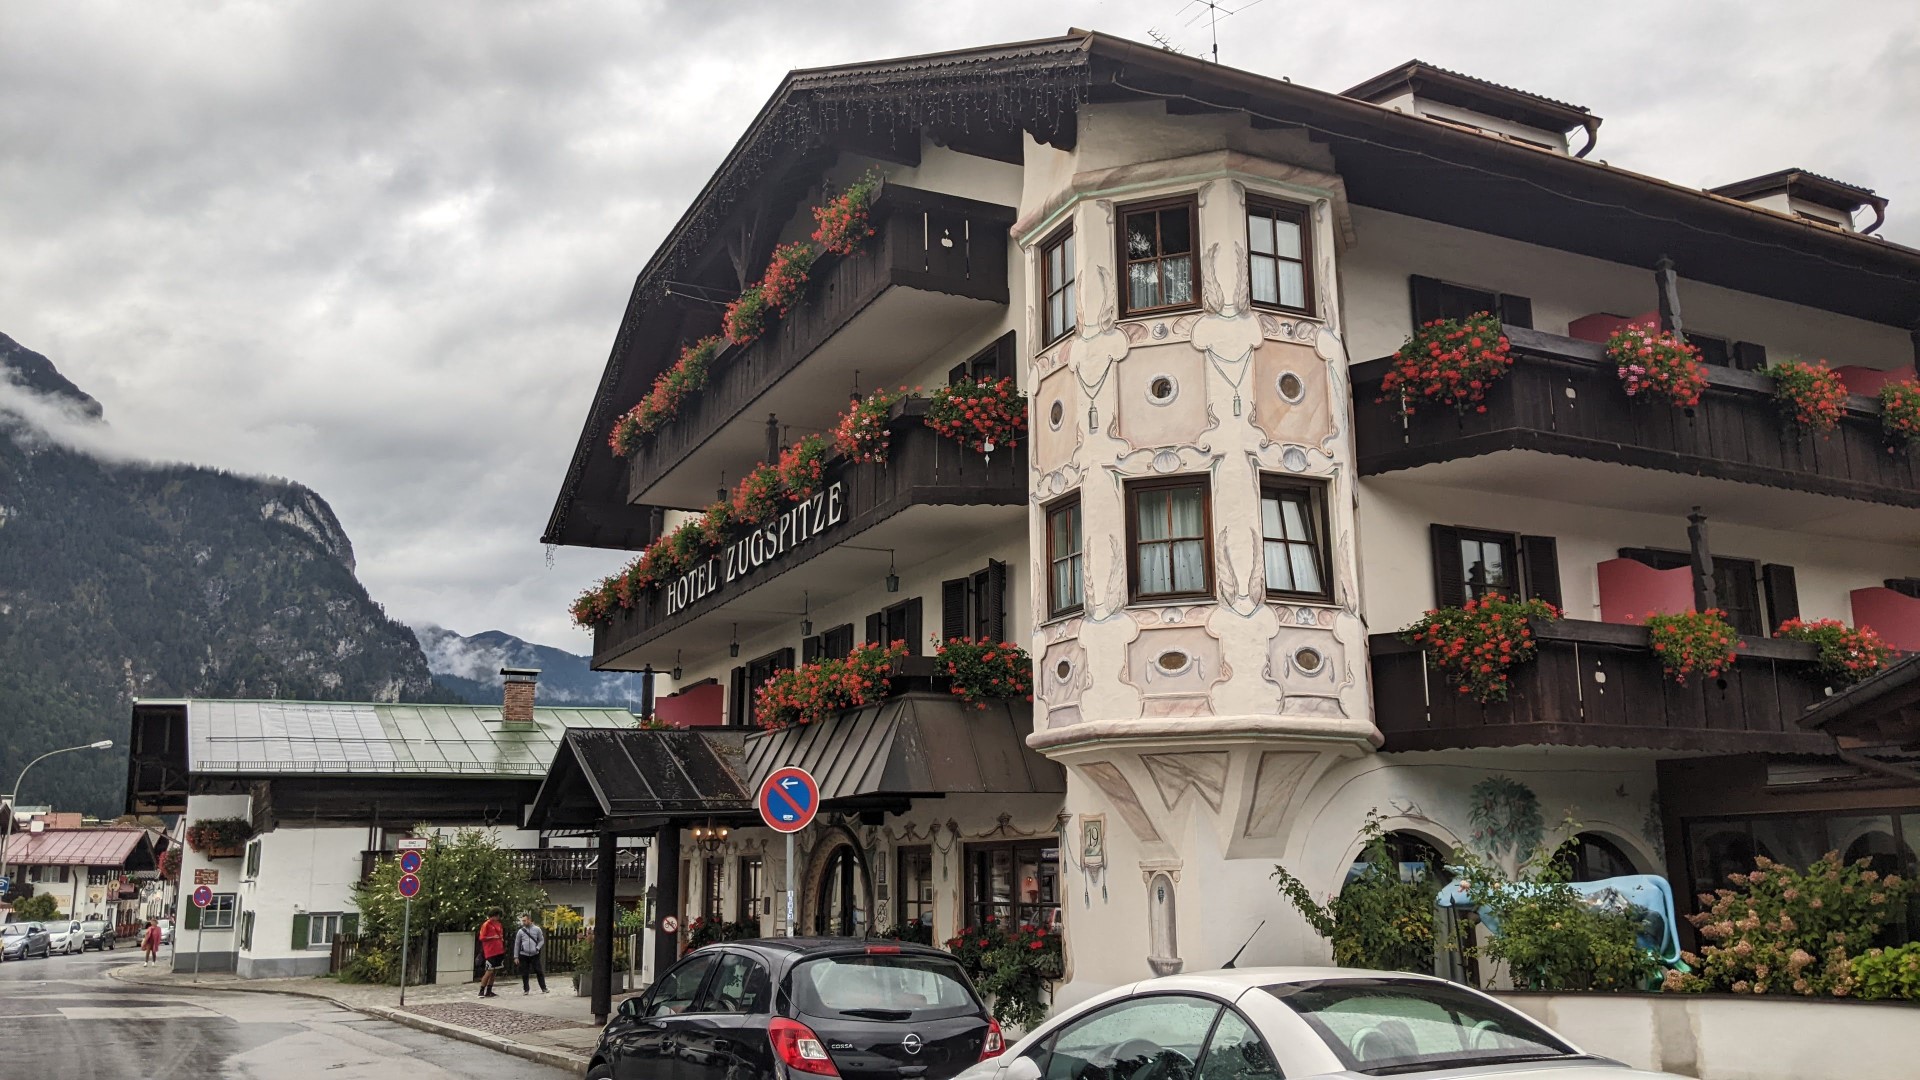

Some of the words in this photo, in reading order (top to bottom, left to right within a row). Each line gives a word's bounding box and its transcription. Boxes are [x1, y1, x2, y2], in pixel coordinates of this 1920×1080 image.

[667, 559, 717, 615] HOTEL
[726, 481, 843, 582] ZUGSPITZE
[1087, 826, 1099, 848] 19
